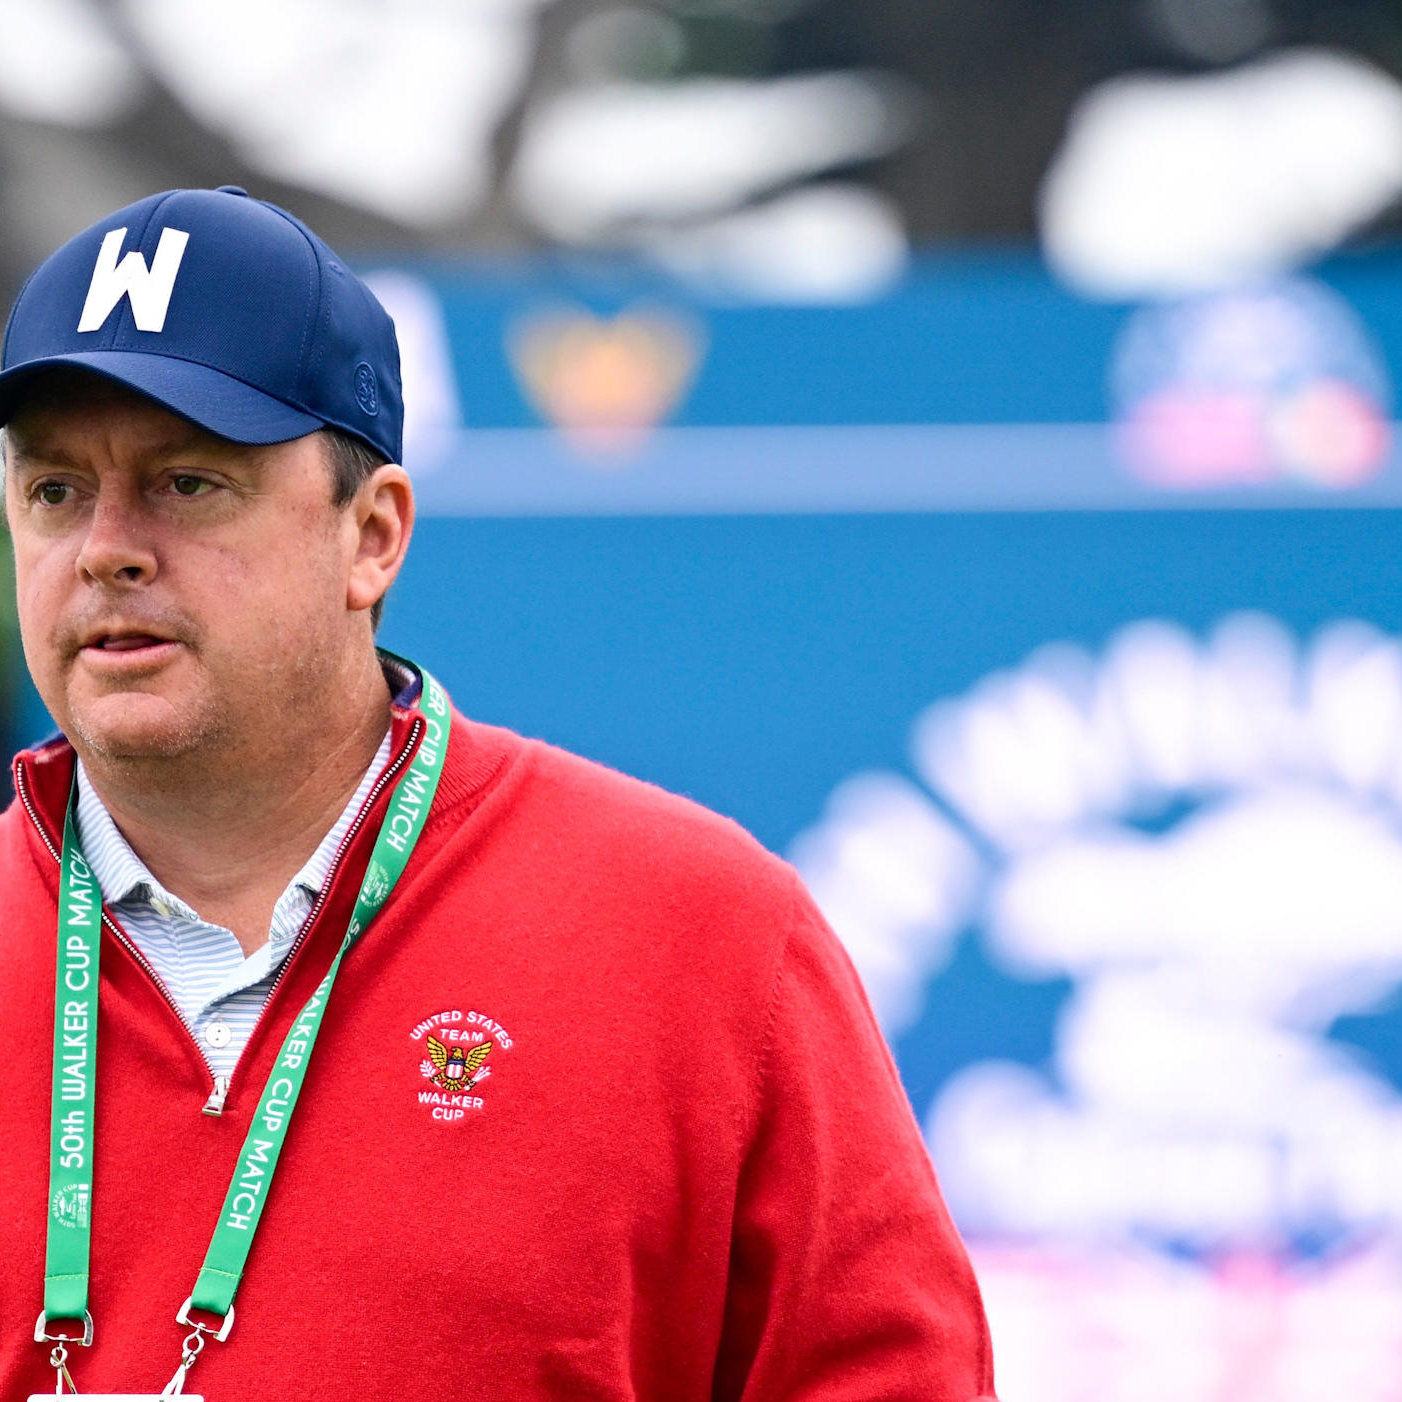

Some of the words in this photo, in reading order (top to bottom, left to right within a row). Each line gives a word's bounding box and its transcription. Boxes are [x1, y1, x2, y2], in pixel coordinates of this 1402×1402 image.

[77, 227, 190, 333] W
[386, 768, 430, 852] MATCH
[68, 848, 94, 925] MATCH
[65, 936, 91, 991] CUP
[61, 1001, 88, 1101] WALKER
[280, 975, 331, 1070] WALKER
[409, 1010, 462, 1040] UNITED
[466, 1010, 513, 1049] STATES
[440, 1028, 484, 1042] TEAM
[262, 1078, 293, 1132] CUP
[418, 1091, 484, 1109] WALKER
[432, 1107, 464, 1121] CUP
[61, 1111, 85, 1168] 50th
[226, 1138, 274, 1231] MATCH
